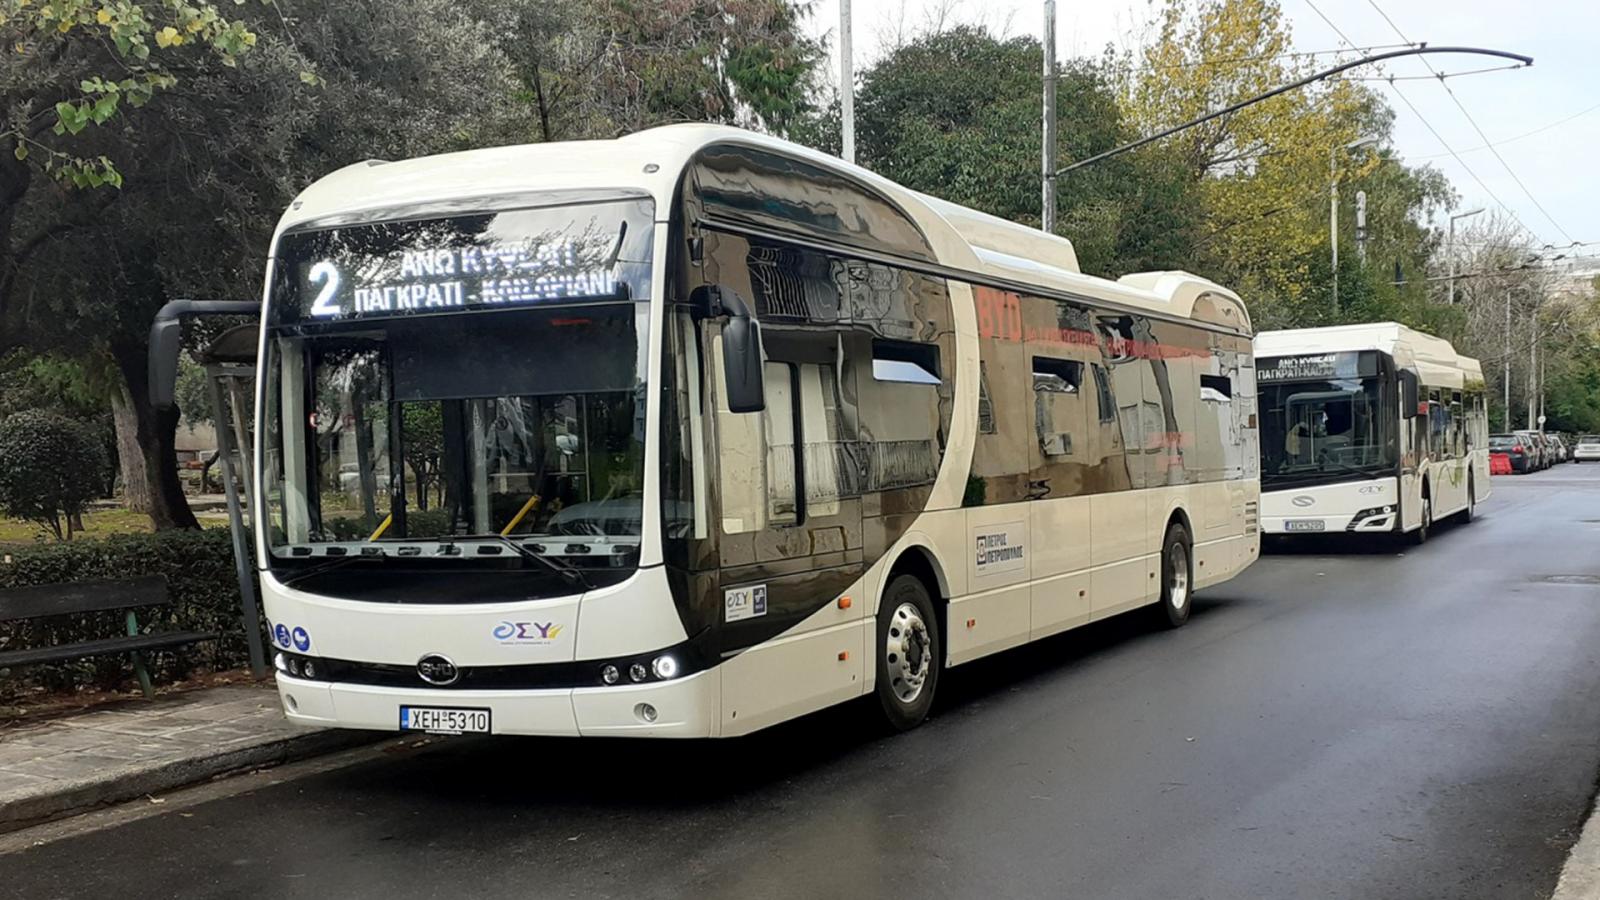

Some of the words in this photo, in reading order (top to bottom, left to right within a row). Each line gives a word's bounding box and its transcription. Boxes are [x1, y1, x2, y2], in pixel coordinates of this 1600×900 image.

[401, 248, 454, 276] ΑΝΩ
[308, 260, 341, 315] 2
[354, 281, 463, 312] ΠΑΓΚΡΑΤΙ
[421, 662, 453, 676] BYD
